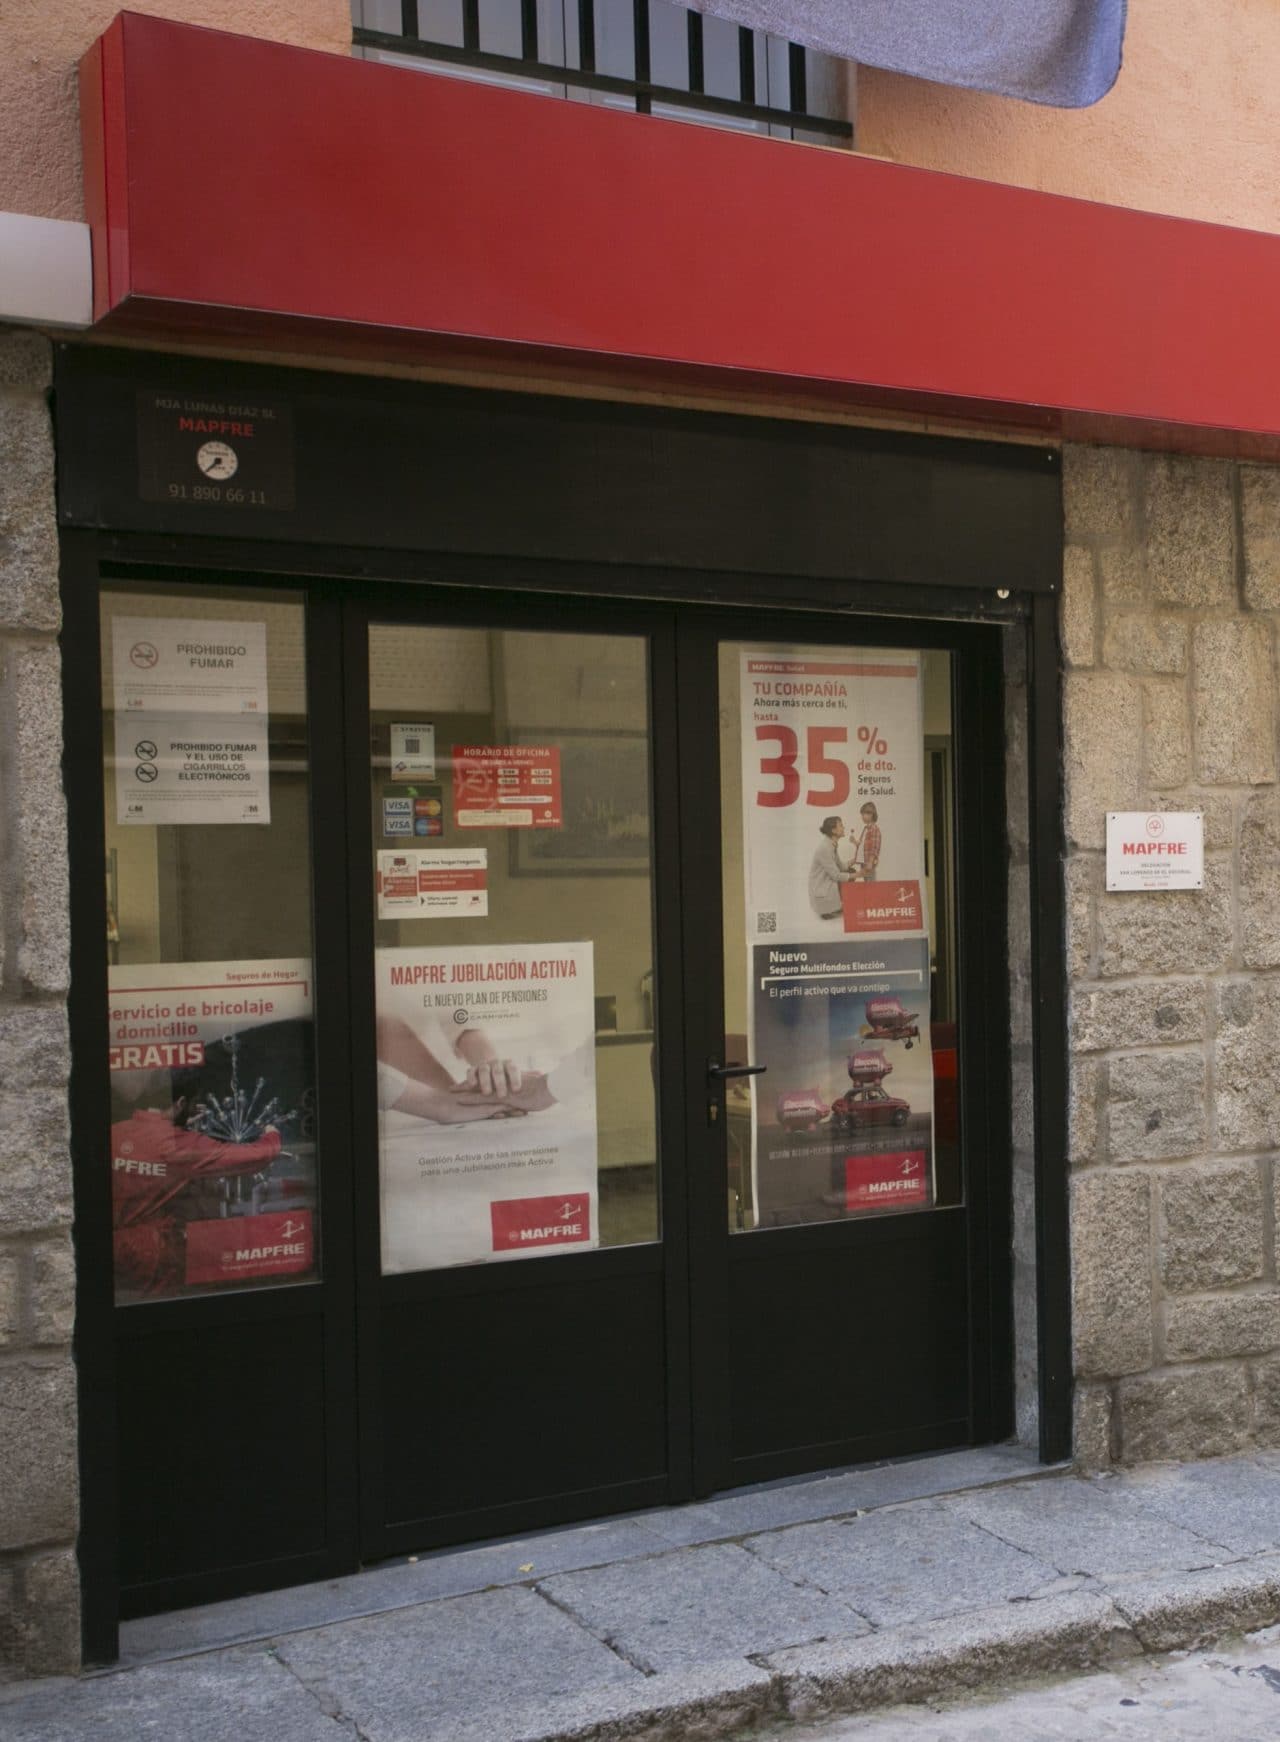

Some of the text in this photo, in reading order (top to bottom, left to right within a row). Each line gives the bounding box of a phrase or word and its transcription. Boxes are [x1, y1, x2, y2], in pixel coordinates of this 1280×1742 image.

[179, 416, 255, 438] MAPFRE
[168, 484, 187, 499] 91
[192, 486, 221, 501] 890
[250, 490, 266, 504] 11
[177, 644, 246, 656] PROHIBIDO
[190, 658, 234, 668] FUMAR
[753, 680, 848, 697] TU COMPAÑÍA
[753, 698, 781, 707] Ahora
[782, 698, 800, 707] más
[802, 700, 824, 708] cerca
[825, 699, 837, 708] de
[753, 711, 778, 721] hasta
[170, 743, 257, 752] PROHIBIDO FUMAR
[463, 748, 502, 757] HORARIO
[183, 763, 246, 771] CIGARRILLOS
[857, 760, 896, 771] de dto.
[178, 771, 251, 781] ELECTRÓNICOS
[857, 774, 891, 785] Seguros
[857, 786, 896, 795] de Salud.
[388, 801, 409, 809] VISA
[388, 821, 410, 829] VISA
[1122, 842, 1187, 855] MAPFRE
[866, 906, 917, 919] MAPFRE
[769, 951, 808, 963] Nuevo
[391, 958, 577, 986] MAPFRE JUBILACIÓN ACTIVA
[769, 965, 799, 976] Seguro
[800, 962, 851, 973] Multifondos
[226, 970, 299, 982] Seguros de Hogar
[423, 988, 548, 1008] EL NUEVO PLAN DE PENSIONES
[769, 987, 778, 998] El
[779, 986, 802, 999] perfil
[803, 985, 829, 996] activo
[830, 985, 846, 996] que
[847, 985, 857, 993] va
[108, 999, 274, 1021] ervicio de bricolaje
[116, 1023, 198, 1040] domicilio
[109, 1042, 204, 1069] GRATIS
[868, 1178, 920, 1193] MAPFRE
[520, 1223, 582, 1241] MAPFRE
[235, 1242, 305, 1262] MAPFRE
